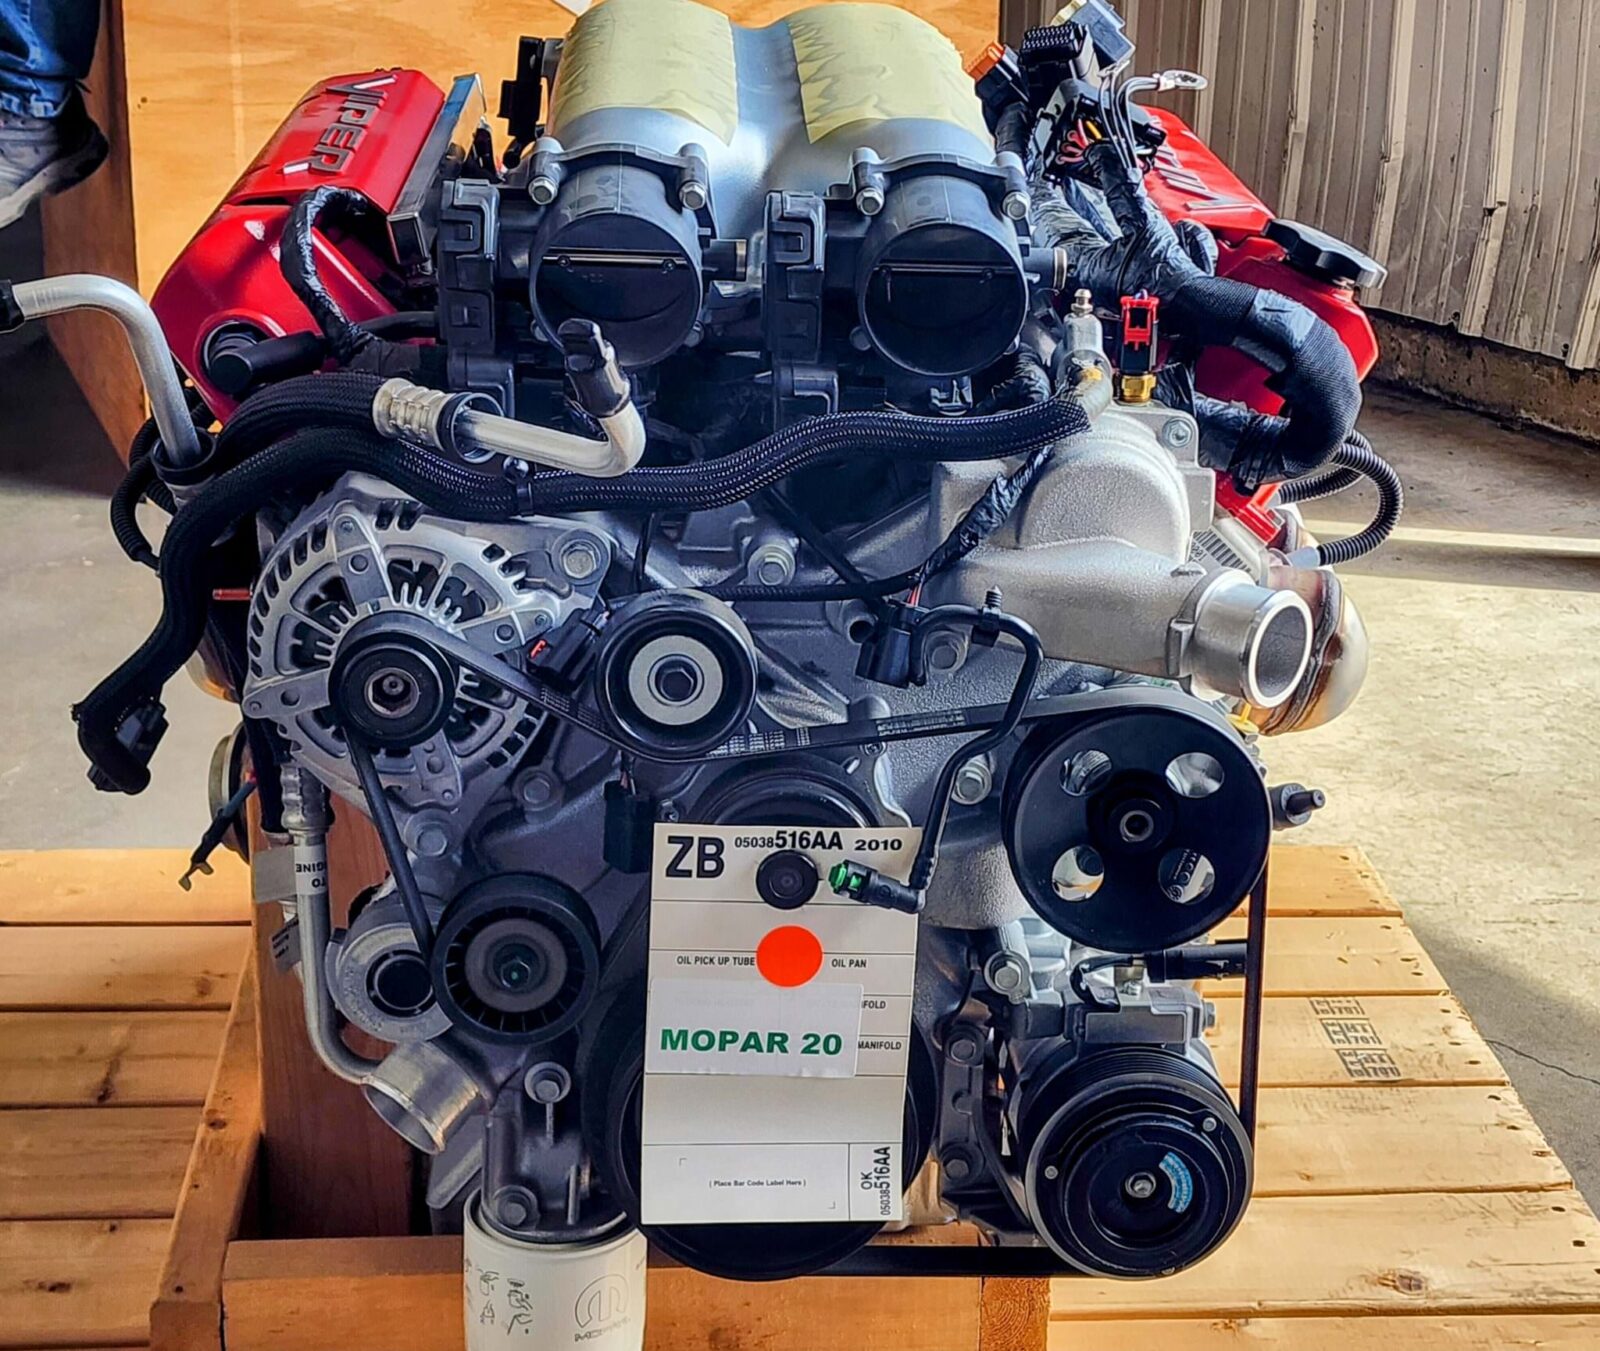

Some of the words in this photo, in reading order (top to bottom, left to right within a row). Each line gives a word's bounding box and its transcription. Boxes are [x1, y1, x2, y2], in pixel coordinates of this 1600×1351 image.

[283, 74, 397, 175] VIPER
[734, 830, 843, 850] 05038516AA
[854, 838, 902, 851] 2010
[666, 835, 725, 878] ZB
[677, 956, 691, 965] OIL
[694, 956, 715, 965] PICK
[718, 957, 730, 965] UP
[732, 957, 755, 966] TUBE
[832, 958, 847, 968] OIL
[849, 958, 867, 968] PAN
[660, 1028, 789, 1054] MOPAR
[800, 1033, 842, 1055] 20
[860, 1171, 873, 1190] OK
[873, 1146, 891, 1216] 05038516AA
